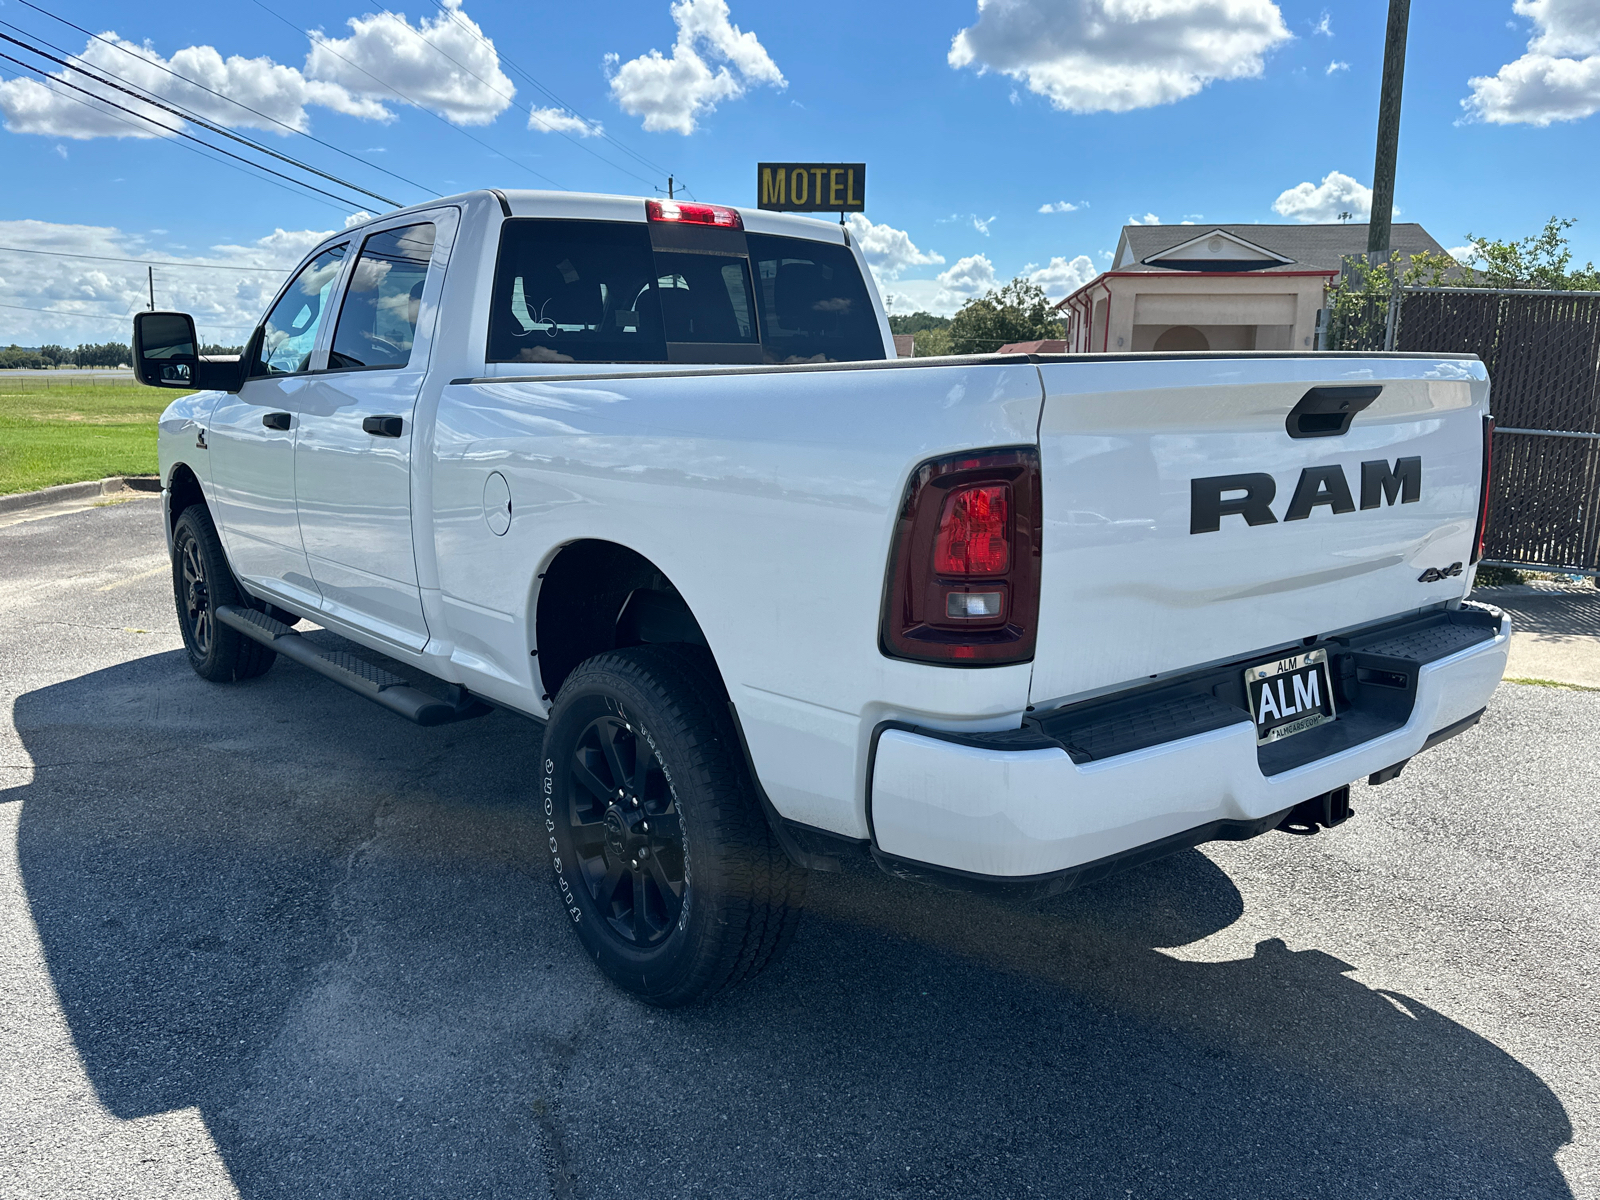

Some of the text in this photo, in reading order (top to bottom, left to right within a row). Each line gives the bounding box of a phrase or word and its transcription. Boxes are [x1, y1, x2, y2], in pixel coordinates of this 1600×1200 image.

[762, 167, 862, 205] MOTEL
[1190, 456, 1421, 535] RAM
[1417, 561, 1463, 583] 4x4
[1276, 657, 1297, 673] ALM
[1258, 669, 1321, 724] ALM
[1276, 716, 1319, 738] ALMCARS.COM
